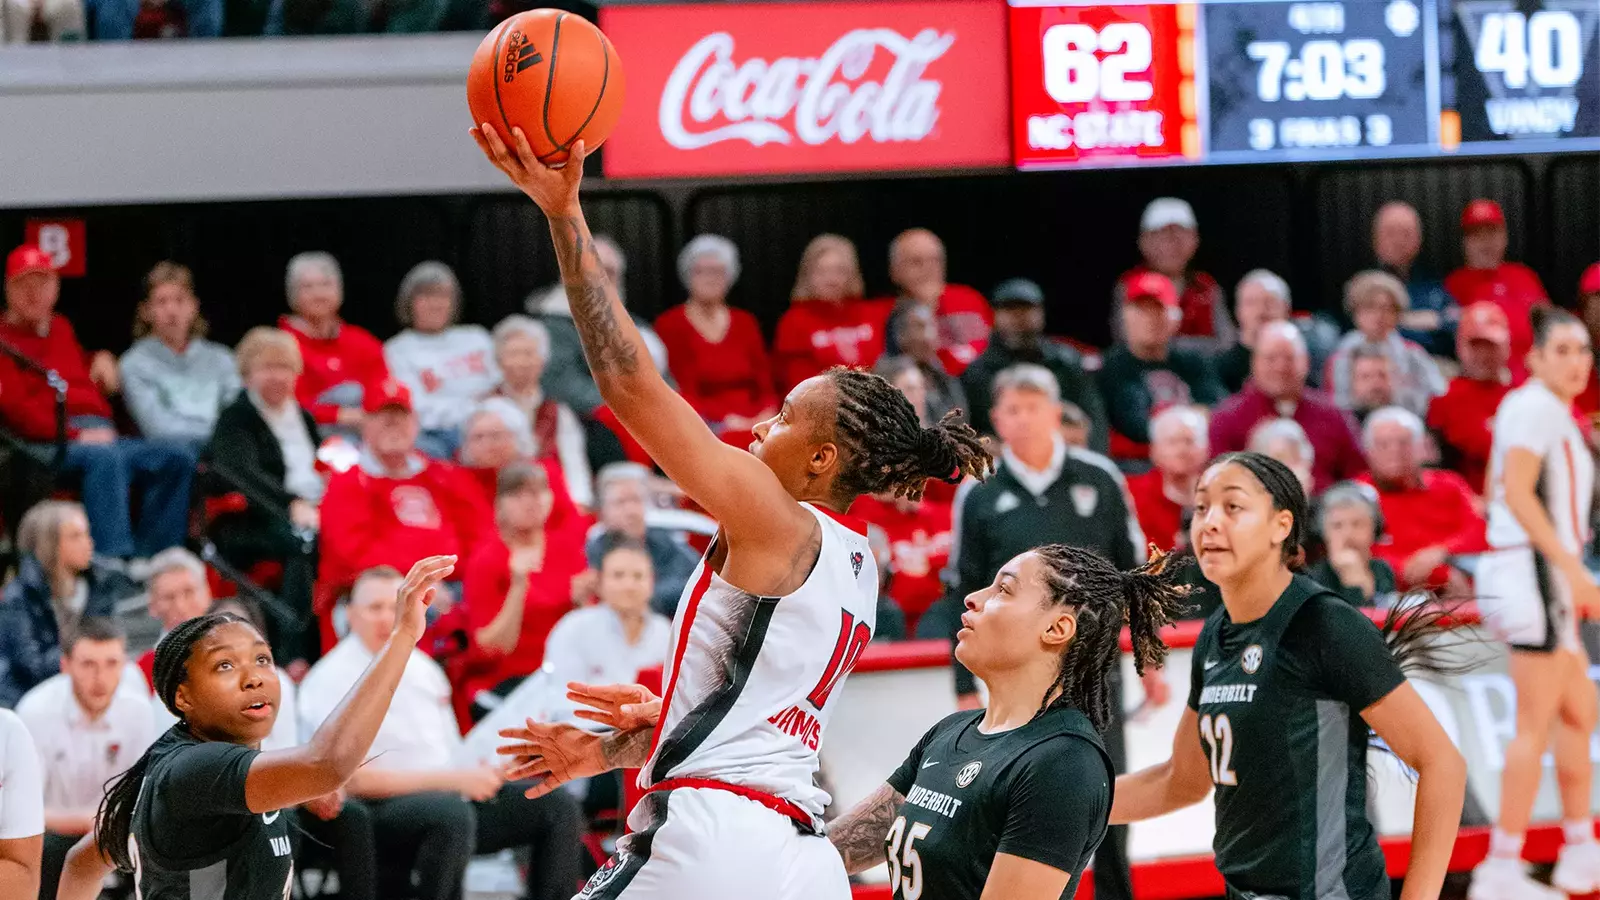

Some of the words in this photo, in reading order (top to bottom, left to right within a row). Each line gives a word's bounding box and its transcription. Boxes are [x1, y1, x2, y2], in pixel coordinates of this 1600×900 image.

[504, 31, 521, 83] adidas
[1043, 23, 1153, 103] 62
[1247, 38, 1386, 102] 7:03
[1474, 11, 1583, 89] 40
[658, 27, 956, 150] Coca-Cola
[1249, 118, 1276, 150] 3
[1365, 114, 1393, 147] 3
[806, 607, 871, 711] 10
[1199, 684, 1257, 705] NDERBILT
[1200, 714, 1237, 786] 12
[885, 816, 932, 900] 35
